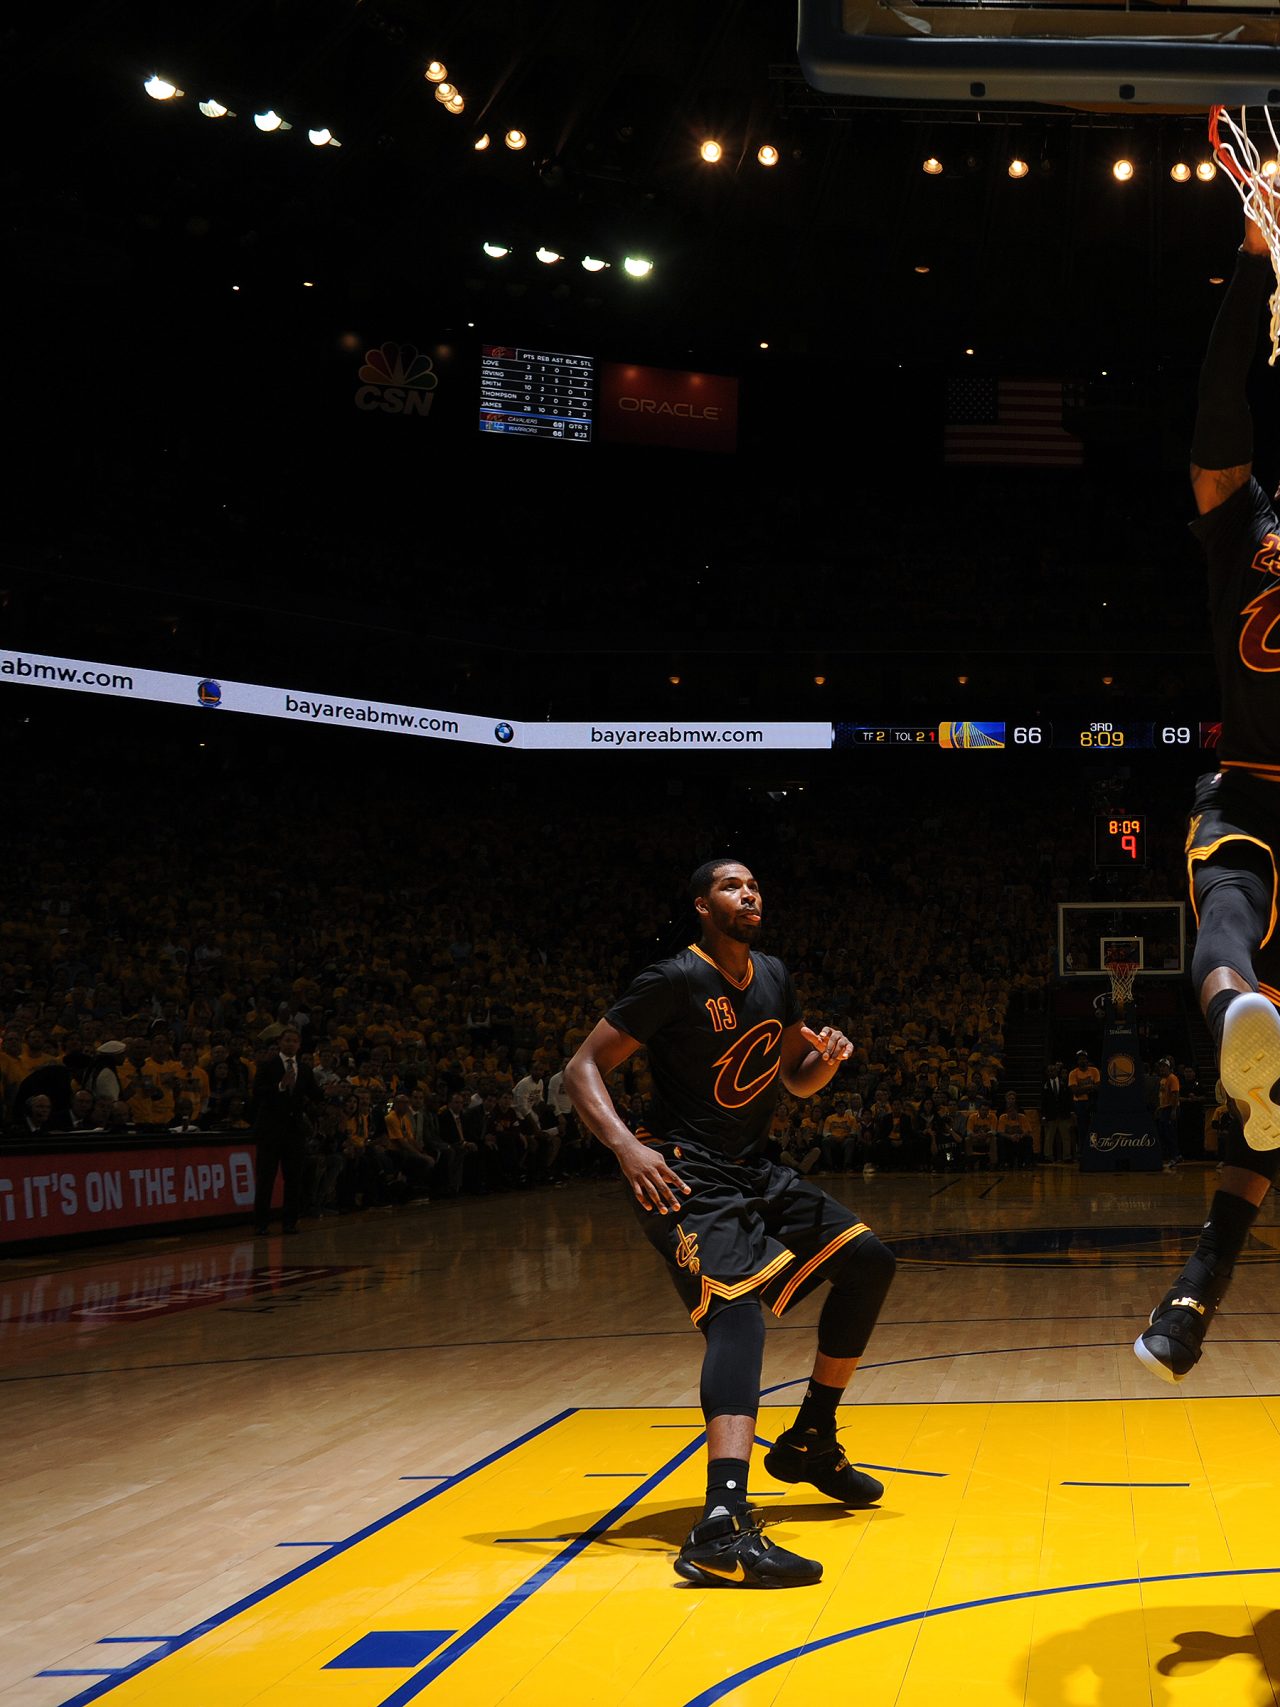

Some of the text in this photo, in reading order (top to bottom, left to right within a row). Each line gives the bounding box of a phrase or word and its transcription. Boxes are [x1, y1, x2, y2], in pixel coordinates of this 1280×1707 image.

[482, 359, 500, 367] LOVE
[482, 370, 505, 378] IRVING
[481, 380, 502, 388] SMITH
[353, 384, 434, 417] CSN
[482, 390, 518, 399] THOMPSON
[618, 396, 722, 421] ORACLE
[507, 416, 538, 425] CAVALIERS
[508, 425, 538, 434] WARRIORS
[285, 694, 460, 734] bayareabmw.com
[590, 727, 764, 745] bayareabmw.com
[1012, 726, 1043, 745] 66
[1089, 722, 1114, 733] 3RD
[1160, 726, 1192, 745] 69
[862, 731, 886, 742] TF 2
[894, 731, 936, 743] TOL 2 1
[1079, 731, 1125, 748] 8:09
[1109, 820, 1141, 835] 8:09
[1121, 835, 1137, 859] 9
[704, 995, 738, 1033] 13
[710, 1018, 784, 1109] C
[1110, 1131, 1157, 1151] Finals
[23, 1172, 80, 1220] IT'S
[84, 1170, 125, 1214] ON
[128, 1167, 178, 1209] THE
[182, 1163, 226, 1202] APP
